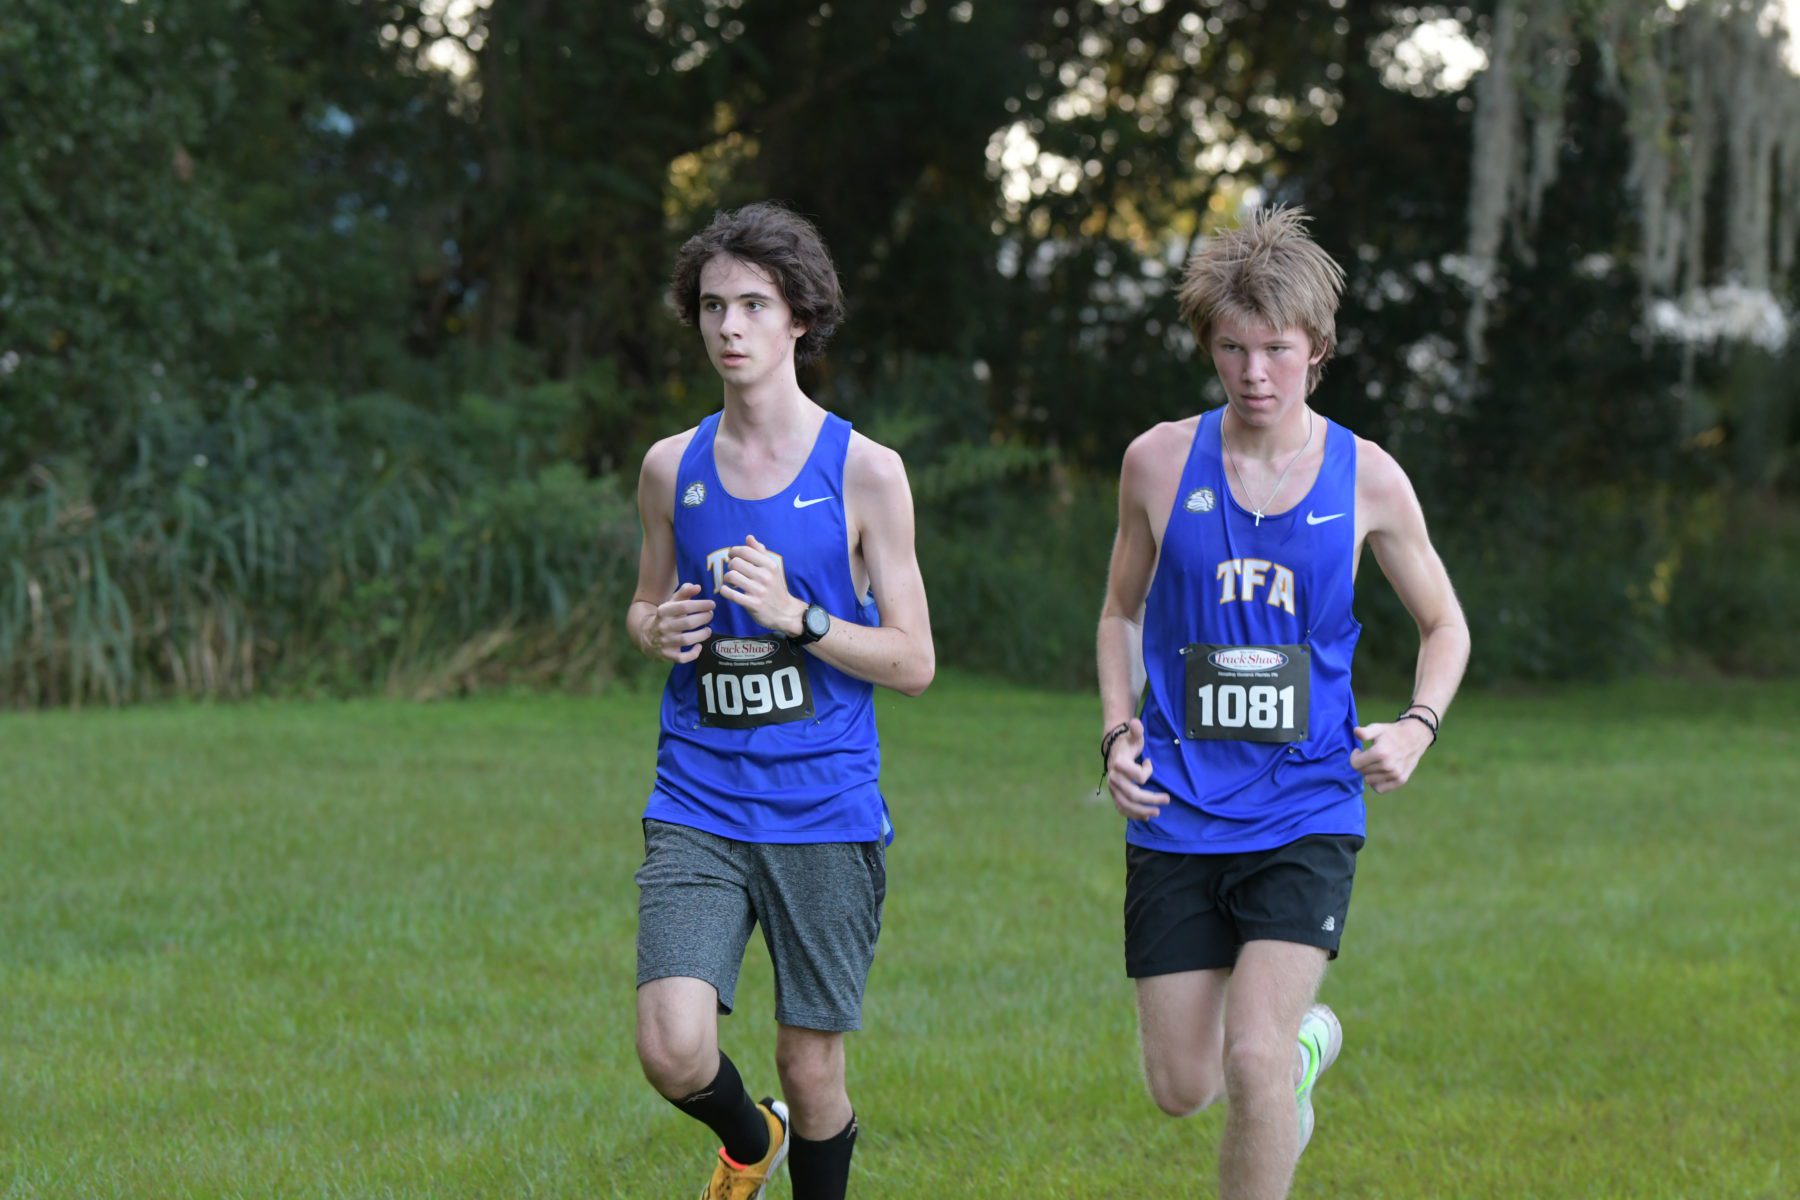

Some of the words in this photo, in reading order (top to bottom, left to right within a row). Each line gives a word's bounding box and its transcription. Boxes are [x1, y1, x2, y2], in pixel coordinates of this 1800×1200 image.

[1216, 558, 1296, 616] TFA
[716, 642, 741, 654] Track
[742, 642, 775, 654] Shack
[1216, 652, 1246, 665] Track
[1248, 652, 1283, 665] Shack
[701, 665, 804, 716] 1090
[1198, 683, 1295, 729] 1081
